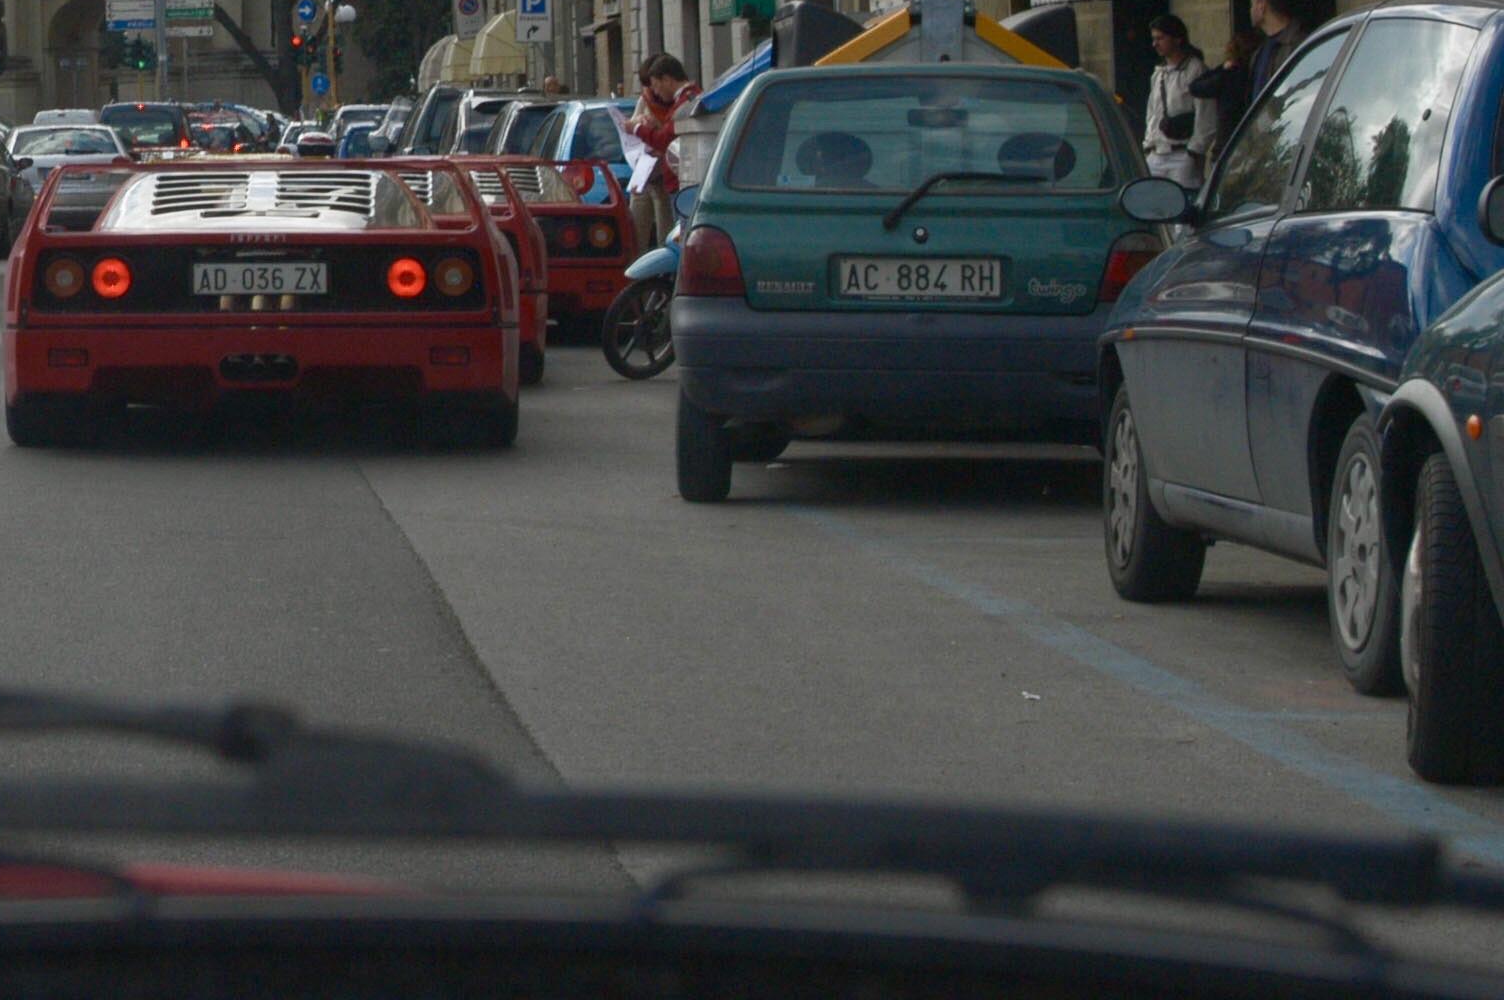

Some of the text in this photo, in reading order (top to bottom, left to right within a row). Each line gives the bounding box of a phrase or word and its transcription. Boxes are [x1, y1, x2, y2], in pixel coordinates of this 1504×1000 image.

[199, 266, 322, 291] AD 036 ZX
[756, 280, 815, 293] RENAULT
[846, 261, 995, 292] AC 884 RH
